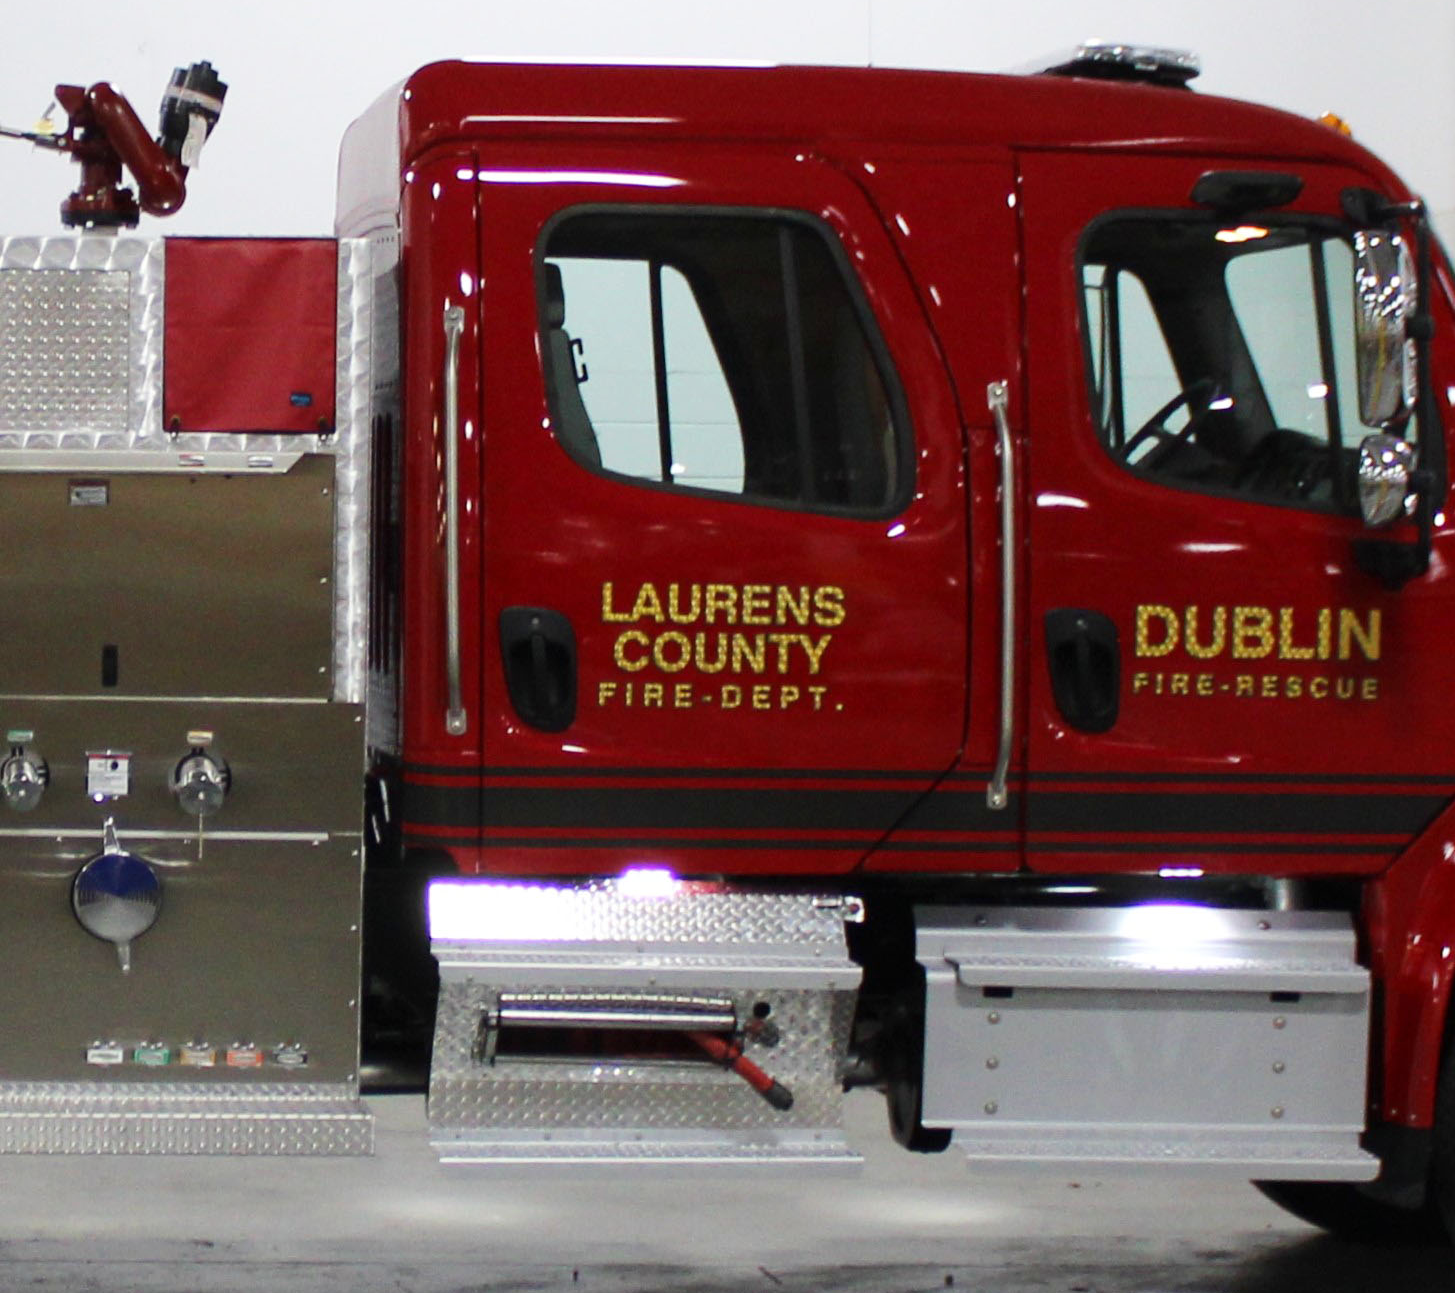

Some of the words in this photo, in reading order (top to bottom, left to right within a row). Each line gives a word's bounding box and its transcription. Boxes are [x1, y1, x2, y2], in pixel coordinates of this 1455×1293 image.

[601, 582, 846, 627] LAURENS
[614, 630, 832, 674] COUNTY
[1135, 604, 1381, 660] DUBLIN
[598, 682, 844, 711] FIRE-DEPT.
[1132, 672, 1379, 700] FIRE-RESCUE
